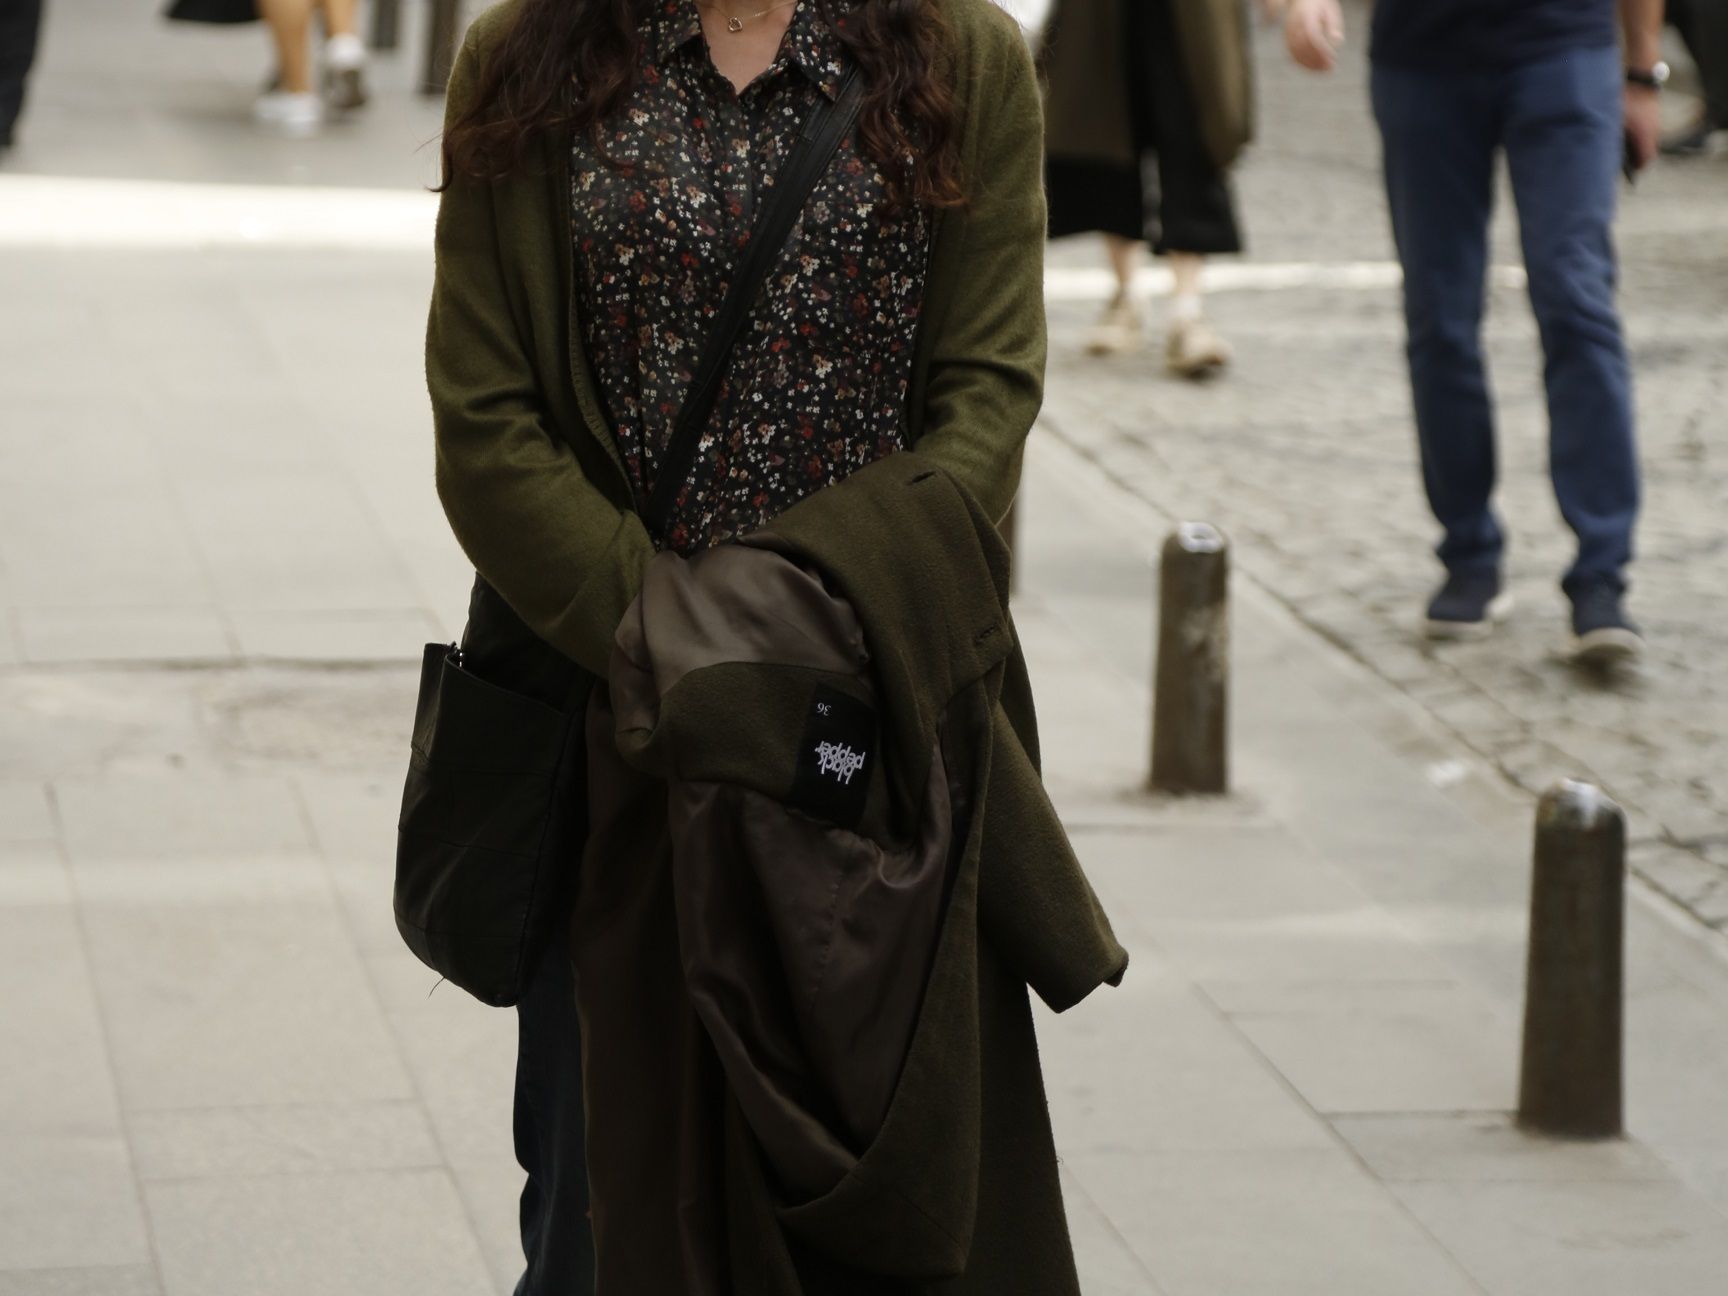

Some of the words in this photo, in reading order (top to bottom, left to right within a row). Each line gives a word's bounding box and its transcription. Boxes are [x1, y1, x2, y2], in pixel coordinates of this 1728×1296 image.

[817, 702, 831, 716] 36
[815, 740, 866, 770] pepper
[818, 752, 856, 784] black
